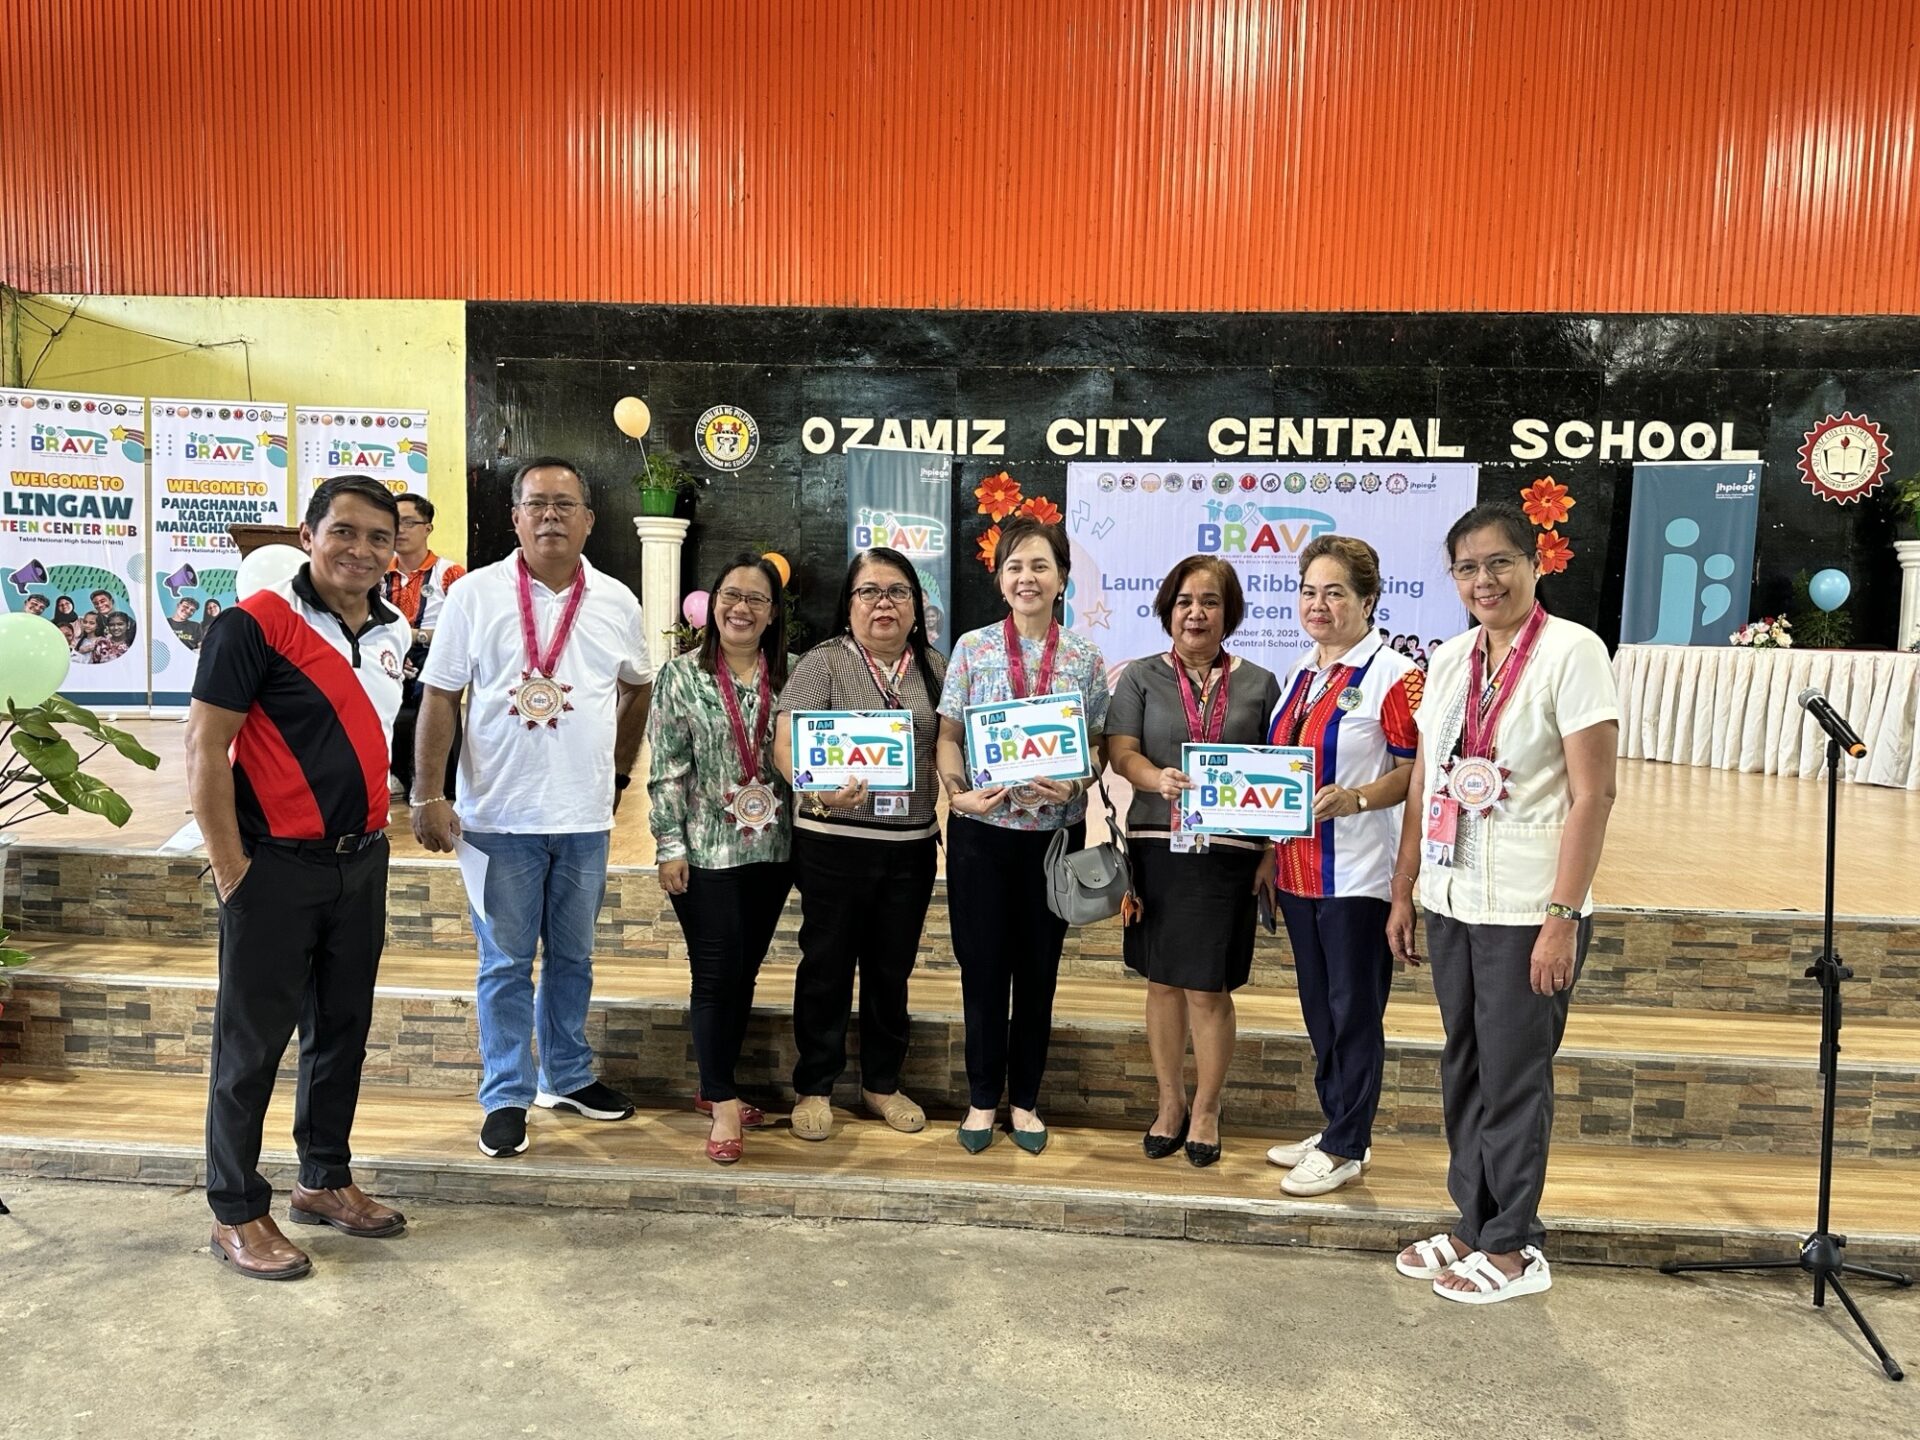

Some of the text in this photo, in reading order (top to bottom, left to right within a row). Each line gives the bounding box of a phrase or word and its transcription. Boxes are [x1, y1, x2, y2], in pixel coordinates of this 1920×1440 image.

[31, 435, 108, 454] BRAVE
[802, 416, 1759, 460] OZAMIZ CITY CENTRAL SCHOOL
[185, 443, 254, 460] BRAVE
[328, 450, 395, 467] BRAVE
[10, 471, 124, 491] WELCOME TO
[167, 479, 267, 496] WELCOME TO
[387, 479, 408, 493] TO
[1716, 482, 1755, 493] jhpiego
[3, 491, 133, 520] LINGAW
[161, 497, 278, 512] PANAGHANAN SA
[178, 510, 262, 523] KABATAANG
[1, 520, 137, 537] TEEN CENTER HUB
[172, 535, 236, 548] TEEN CEN
[856, 526, 944, 551] BRAVE
[1247, 574, 1300, 592] Ribb
[1380, 576, 1424, 598] ting
[1244, 602, 1292, 619] Teen
[1233, 629, 1299, 638] mber 26, 2025
[1233, 639, 1265, 647] Central
[1267, 639, 1297, 648] School
[808, 720, 834, 730] I AM
[980, 711, 1006, 726] I AM
[810, 746, 903, 766] BRAVE
[985, 732, 1077, 764] BRAVE
[1200, 754, 1228, 766] I AM
[1200, 785, 1302, 810] BRAVE
